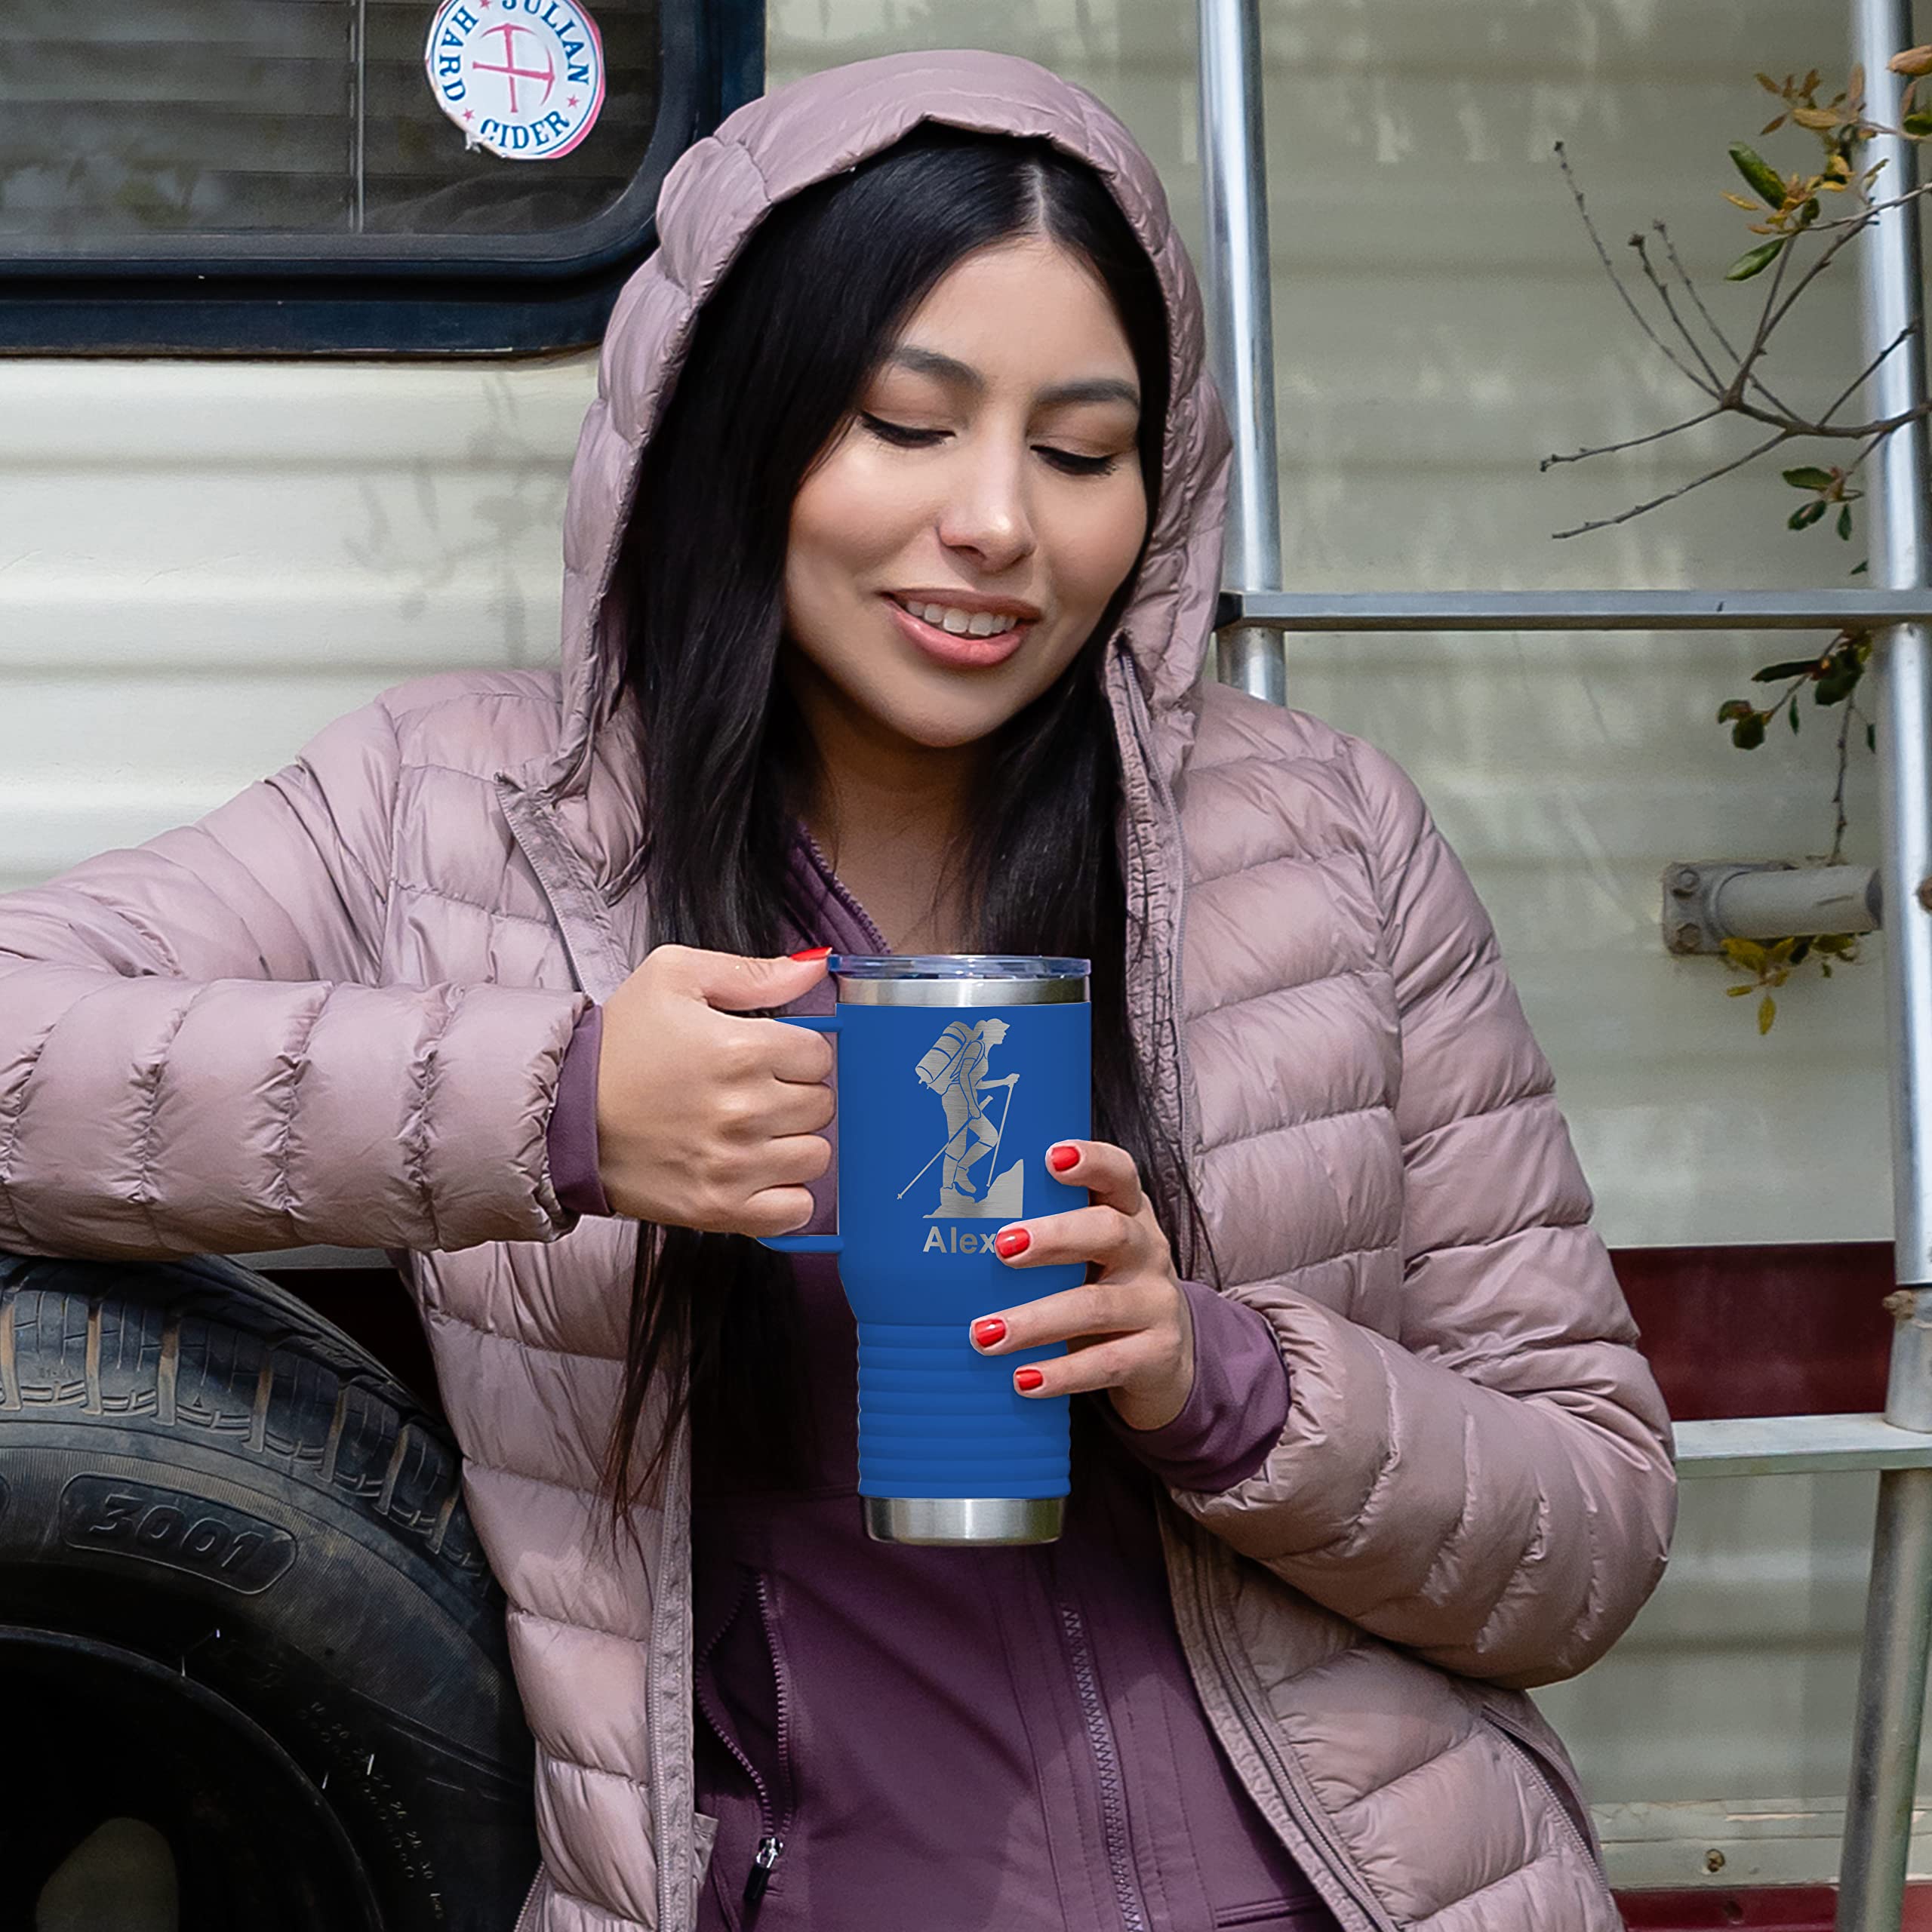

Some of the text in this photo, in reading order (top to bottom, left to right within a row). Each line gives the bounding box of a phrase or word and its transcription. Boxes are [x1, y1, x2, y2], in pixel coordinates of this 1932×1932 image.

[439, 6, 478, 101] HARD
[480, 111, 570, 149] CIDER
[89, 1494, 264, 1571] 3001
